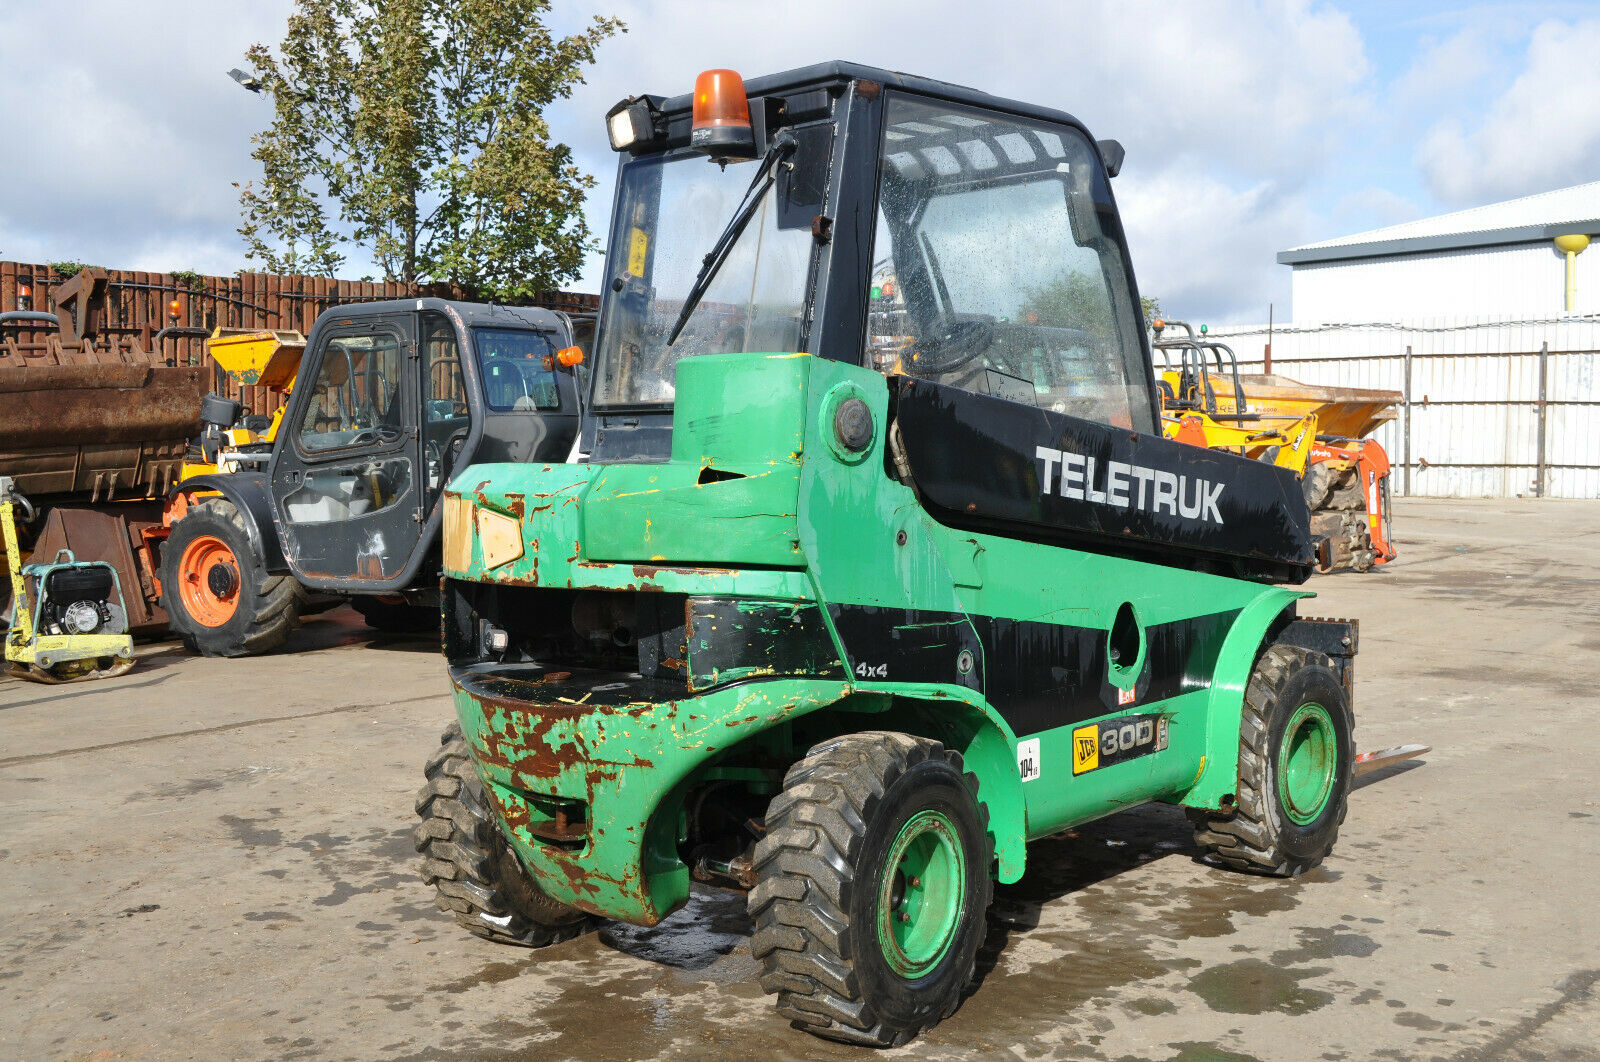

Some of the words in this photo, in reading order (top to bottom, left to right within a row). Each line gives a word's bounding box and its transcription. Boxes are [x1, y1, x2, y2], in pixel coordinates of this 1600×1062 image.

[1036, 446, 1225, 524] TELETRUK
[856, 662, 888, 677] 4x4
[1078, 739, 1096, 761] JCB
[1101, 720, 1154, 756] 30D
[1020, 758, 1033, 778] 104
